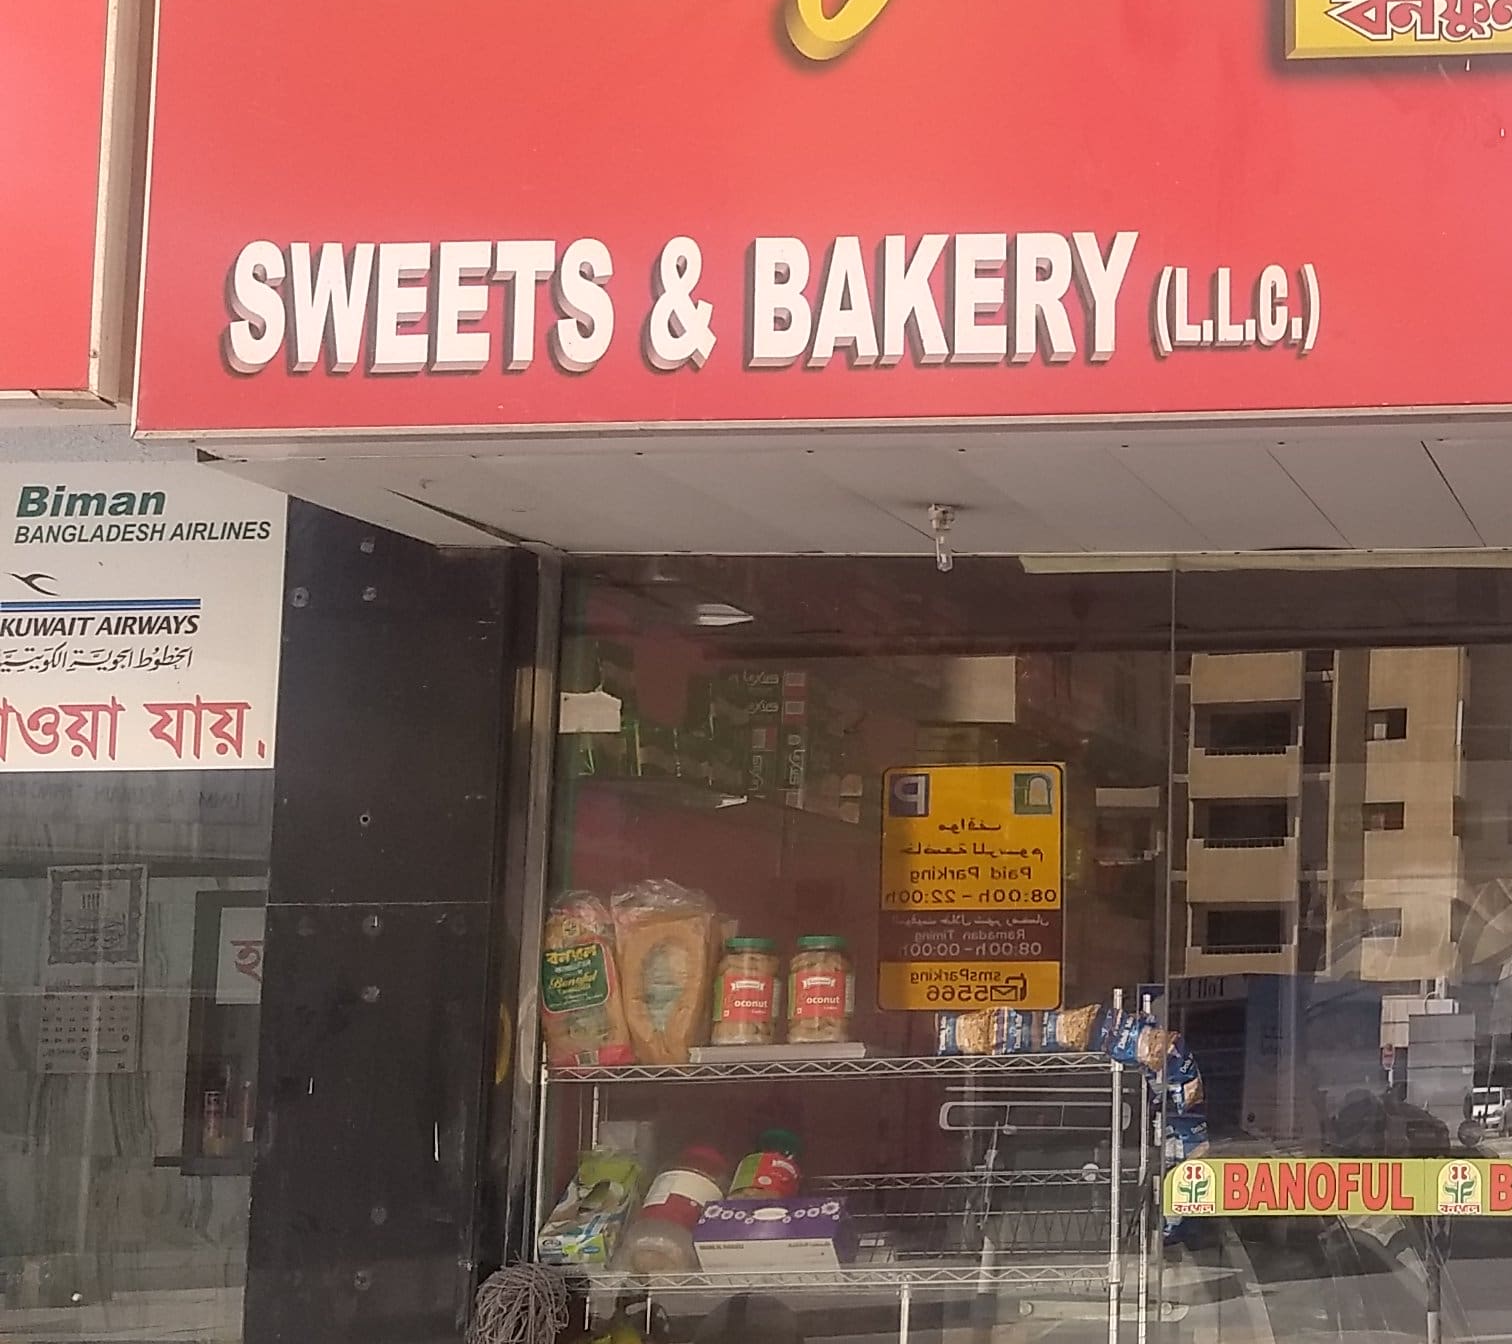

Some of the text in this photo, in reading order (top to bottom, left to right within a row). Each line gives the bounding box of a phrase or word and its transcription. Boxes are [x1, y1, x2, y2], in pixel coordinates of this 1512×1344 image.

[226, 229, 1321, 372] SWEETS & BAKERY (L.L.C.)
[15, 485, 167, 518] Biman
[14, 521, 272, 544] BANGLADESH AIRLINES
[0, 614, 200, 637] KUWAIT AIRWAYS
[731, 998, 769, 1009] oconut
[803, 994, 840, 1005] oconut
[1222, 1161, 1415, 1211] BANOFUL
